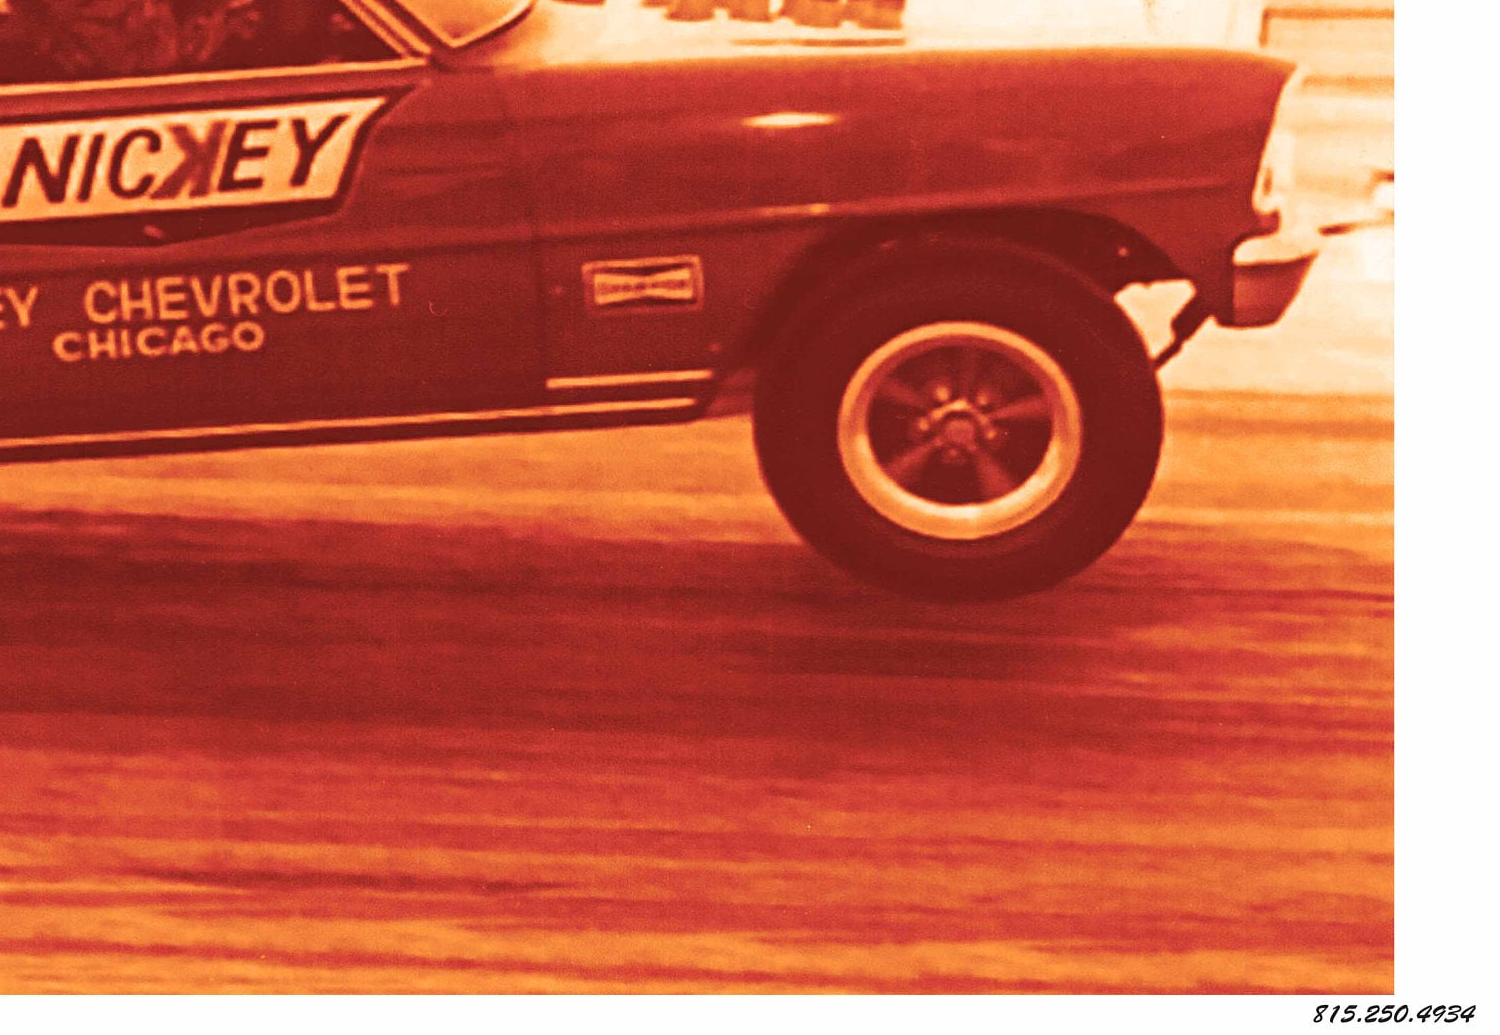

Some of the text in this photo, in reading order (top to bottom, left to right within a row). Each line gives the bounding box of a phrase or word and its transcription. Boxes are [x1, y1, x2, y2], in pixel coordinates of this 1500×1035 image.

[0, 112, 350, 209] NICKEY
[83, 264, 410, 326] CHEVROLET
[52, 321, 266, 363] CHICAGO
